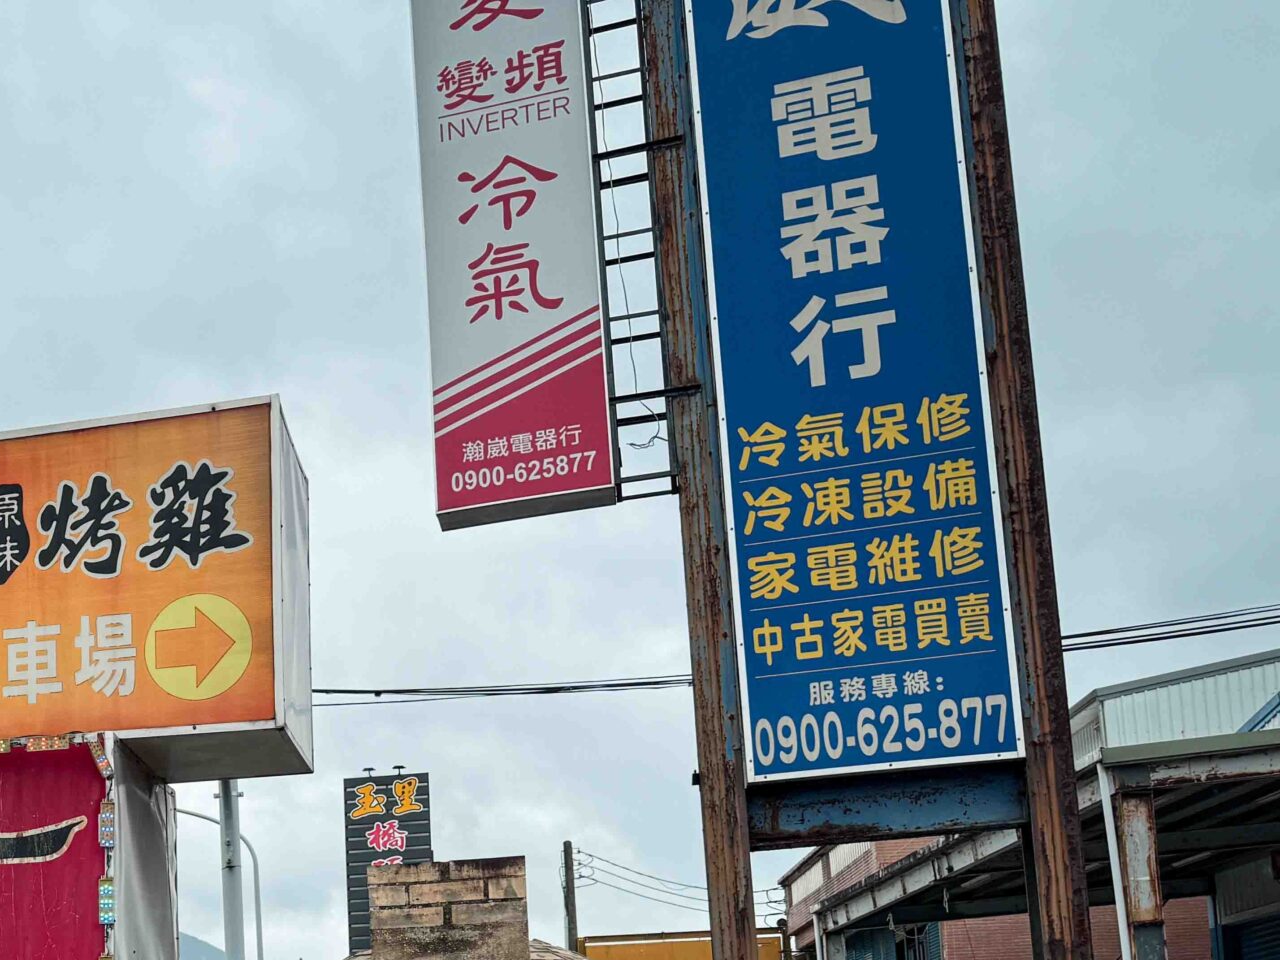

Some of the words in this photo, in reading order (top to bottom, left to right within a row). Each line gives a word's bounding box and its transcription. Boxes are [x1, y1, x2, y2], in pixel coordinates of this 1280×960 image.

[437, 39, 568, 110] 變頻
[438, 95, 571, 143] INVERTER
[457, 154, 564, 324] 冷氣
[738, 393, 970, 471] 冷氣保修
[451, 450, 597, 492] 0900-625877
[742, 457, 978, 535] 冷凍設備
[38, 459, 254, 578] 烤雞
[747, 526, 985, 600] 家電維修
[752, 592, 994, 666] 中古家電買賣
[754, 694, 1008, 767] 0900-625-877
[365, 819, 408, 866] 橋
